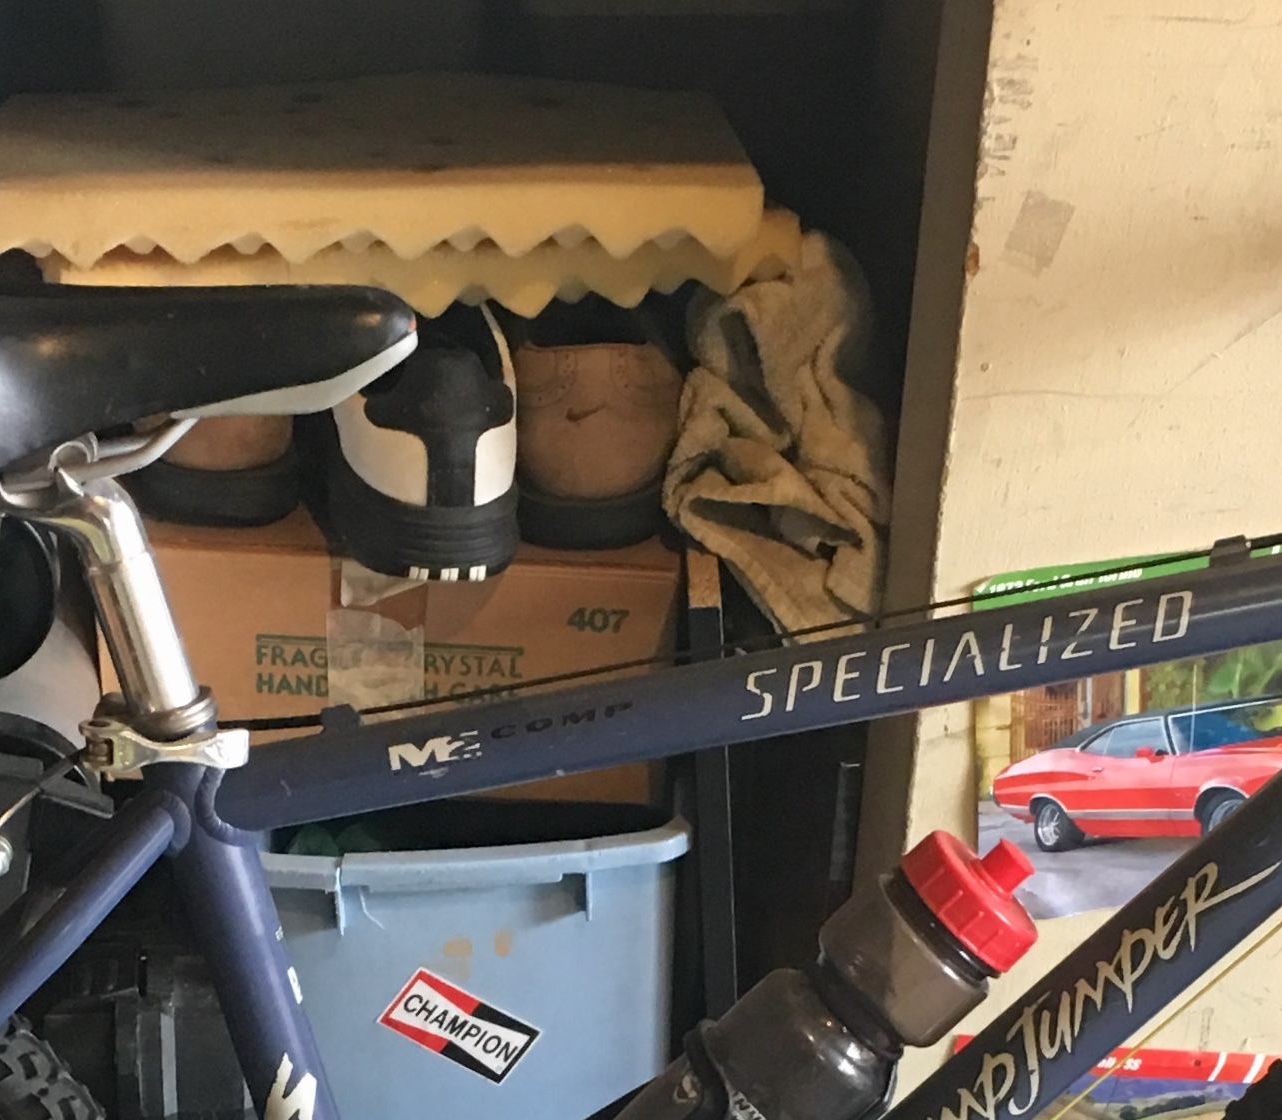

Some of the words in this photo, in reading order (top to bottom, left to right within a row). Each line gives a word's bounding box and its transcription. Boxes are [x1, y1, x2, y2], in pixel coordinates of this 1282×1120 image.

[567, 607, 630, 634] 407
[255, 645, 328, 670] FRAG
[424, 653, 523, 679] RYSTAL
[741, 590, 1193, 721] SPECIALIZED
[255, 672, 328, 697] HAND
[490, 701, 633, 740] COMP
[403, 994, 519, 1063] CHAMPION
